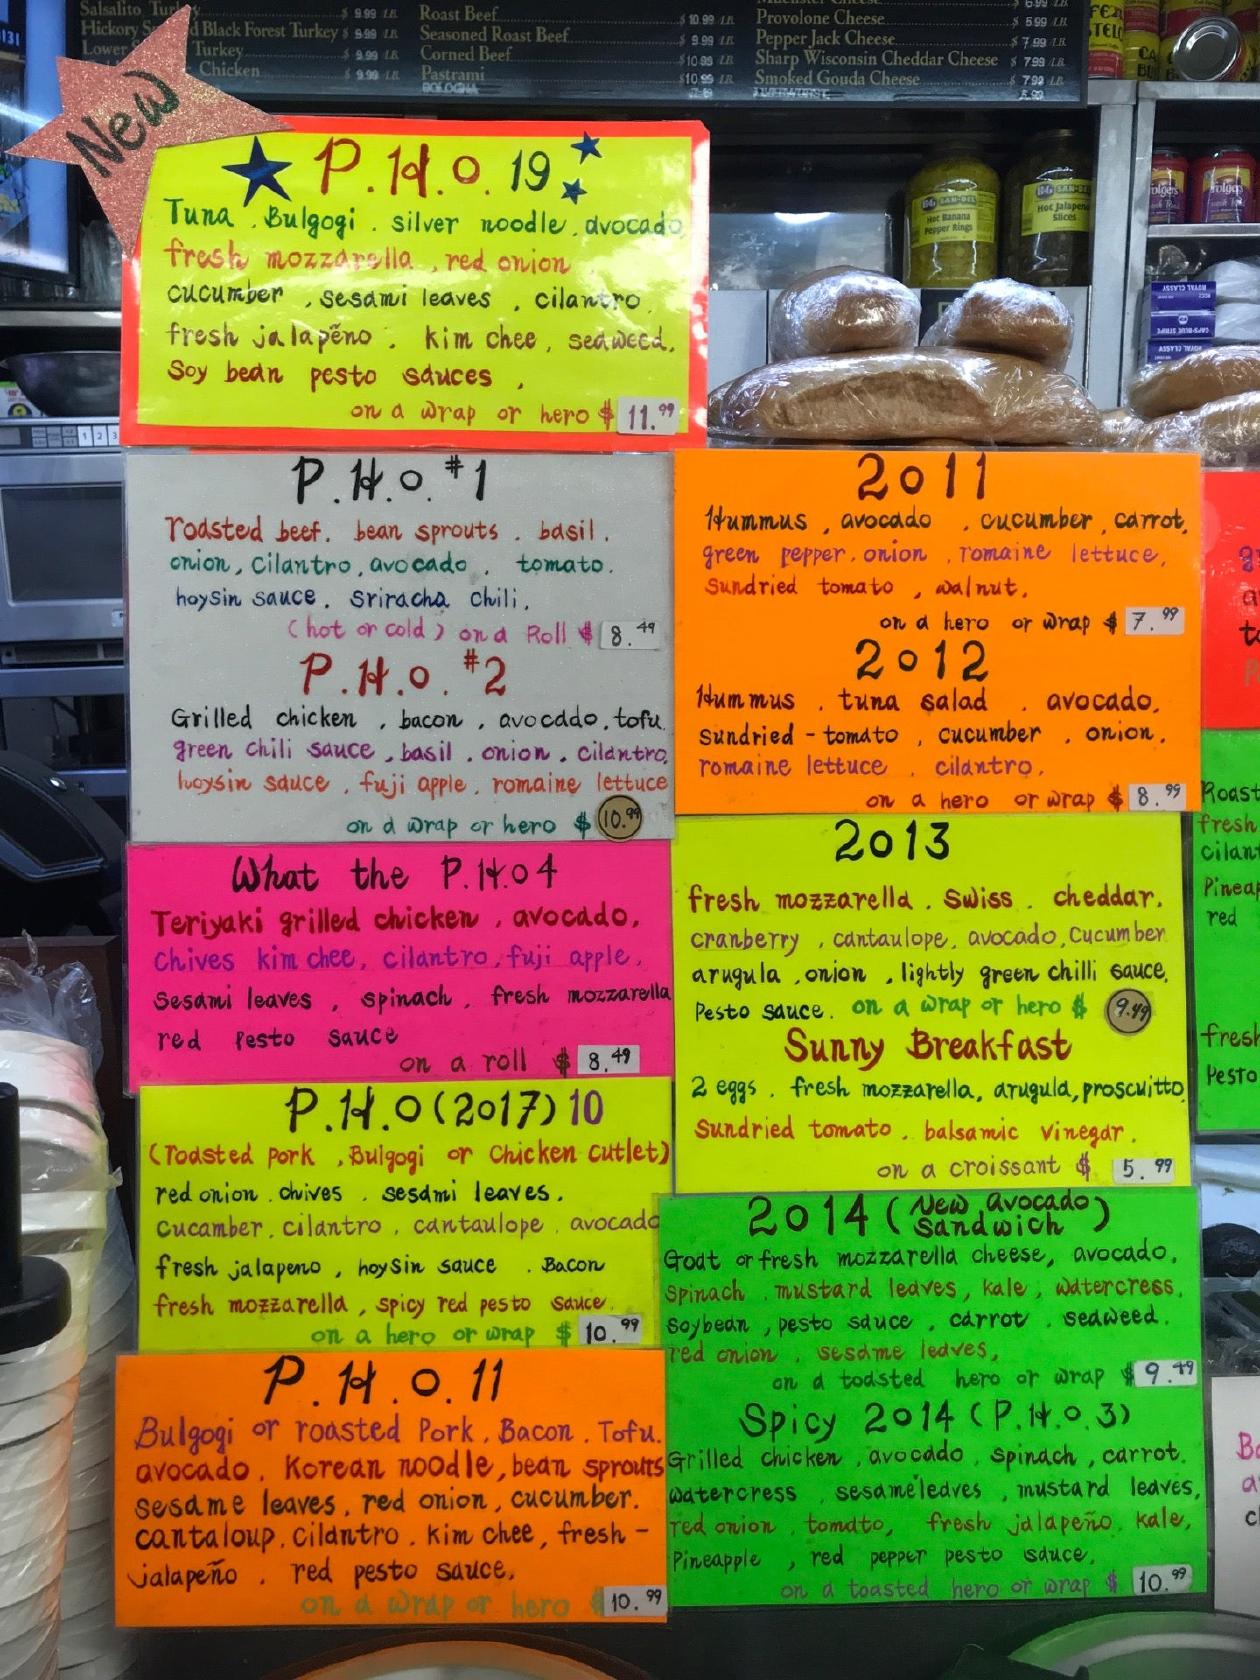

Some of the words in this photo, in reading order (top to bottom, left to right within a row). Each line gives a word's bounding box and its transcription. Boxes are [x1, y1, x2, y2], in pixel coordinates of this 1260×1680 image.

[355, 8, 377, 19] 9.99
[419, 4, 461, 21] Roast
[465, 5, 499, 21] Beef
[756, 8, 830, 25] Provolone
[834, 10, 885, 25] Cheese
[81, 19, 139, 40] Hickory
[202, 20, 241, 37] Black
[244, 21, 285, 38] Forest
[289, 22, 338, 43] Turkey
[355, 28, 377, 40] 9.99
[420, 24, 487, 41] Seasoned
[492, 26, 532, 42] Roast
[536, 26, 571, 43] Beef
[691, 35, 714, 46] 9.99
[756, 29, 808, 50] Pepper
[808, 29, 840, 48] Jack
[845, 30, 896, 46] Cheese
[1022, 36, 1047, 49] 7.99
[82, 40, 126, 56] Lower
[193, 41, 243, 59] Turkey
[356, 50, 378, 60] 9.99
[421, 45, 475, 61] Corned
[479, 46, 513, 62] Beef
[755, 50, 799, 70] Sharp
[804, 50, 877, 66] Wisconsin
[882, 51, 944, 66] Cheddar
[948, 51, 998, 66] Cheese
[1023, 57, 1046, 68] 7.99
[199, 61, 260, 78] Chicken
[356, 70, 379, 80] 9.99
[421, 65, 485, 81] Pastrami
[755, 69, 812, 85] Smoked
[816, 70, 865, 85] Gouda
[870, 70, 920, 86] Cheese
[1021, 75, 1044, 85] 7.99
[66, 70, 179, 178] New
[511, 150, 550, 192] 19
[163, 198, 234, 227] Tuna
[392, 211, 459, 234] silver
[481, 209, 566, 234] noodle
[163, 237, 248, 270] fresh
[266, 247, 413, 274] mozzarella
[445, 248, 487, 272] red
[498, 249, 570, 274] onion
[168, 280, 283, 304] cucumber
[167, 322, 238, 347] fresh
[426, 325, 473, 349] kim
[168, 360, 207, 385] Soy
[225, 361, 283, 383] bean
[311, 365, 376, 392] pesto
[403, 364, 492, 387] sauces
[421, 401, 475, 426] wrap
[541, 404, 589, 426] hero
[858, 453, 988, 500] 2011
[165, 515, 263, 542] roasted
[354, 520, 402, 542] bean
[415, 521, 498, 545] sprouts
[705, 505, 807, 531] Hummus
[841, 506, 931, 529] avocado
[981, 507, 1092, 531] cucumber
[960, 544, 1051, 562] romaine
[177, 587, 241, 611] hoysin
[818, 578, 893, 595] tomato
[528, 622, 566, 644] Roll
[856, 639, 988, 682] 2012
[838, 688, 900, 711] tuna
[921, 687, 987, 712] salad
[172, 704, 252, 729] Grilled
[277, 706, 357, 727] chicken
[939, 720, 1041, 744] cucumber
[173, 740, 232, 762] green
[246, 738, 291, 759] chili
[307, 742, 375, 759] sauce
[807, 755, 887, 776] lettuce
[360, 770, 404, 799] fuji
[493, 778, 581, 794] romaine
[598, 772, 668, 792] lettuce
[835, 819, 949, 862] 2013
[232, 854, 319, 893] What
[351, 857, 409, 890] the
[775, 885, 913, 911] mozzarella
[151, 907, 263, 940] Teriyaki
[280, 907, 360, 937] grilled
[375, 905, 479, 930] chicken
[1207, 909, 1237, 926] red
[691, 928, 799, 957] cranberry
[692, 962, 780, 991] arugula
[902, 961, 964, 987] lightly
[1048, 959, 1096, 981] chilli
[361, 984, 452, 1014] spinach
[491, 984, 549, 1005] fresh
[568, 980, 675, 1006] mozzarella
[784, 1027, 884, 1071] Sunny
[906, 1027, 1072, 1060] Breakfast
[790, 1076, 850, 1097] fresh
[570, 1089, 603, 1125] 10
[925, 1117, 1018, 1141] balsamic
[349, 1144, 423, 1176] Bulgogi
[950, 1155, 1060, 1177] croissant
[382, 1179, 456, 1203] sesami
[414, 1212, 543, 1239] cantaulope
[744, 1191, 872, 1236] 2014
[542, 1257, 605, 1273] Bacon
[837, 1246, 957, 1267] mozzarella
[775, 1278, 872, 1300] mustard
[983, 1277, 1027, 1297] kale
[376, 1298, 424, 1319] spicy
[480, 1296, 531, 1317] pesto
[386, 1322, 435, 1346] hero
[779, 1314, 832, 1337] pesto
[950, 1311, 1028, 1328] carrot
[840, 1368, 924, 1390] toasted
[739, 1403, 836, 1443] Spicy
[865, 1400, 954, 1434] 2014
[135, 1416, 233, 1456] Bulgogi
[296, 1413, 400, 1443] roasted
[286, 1454, 385, 1480] Korean
[583, 1453, 665, 1478] sprouts
[990, 1445, 1076, 1472] spinach
[135, 1495, 244, 1520] sesame
[926, 1511, 991, 1532] fresh
[674, 1550, 760, 1574] Pineapple
[871, 1549, 927, 1570] pepper
